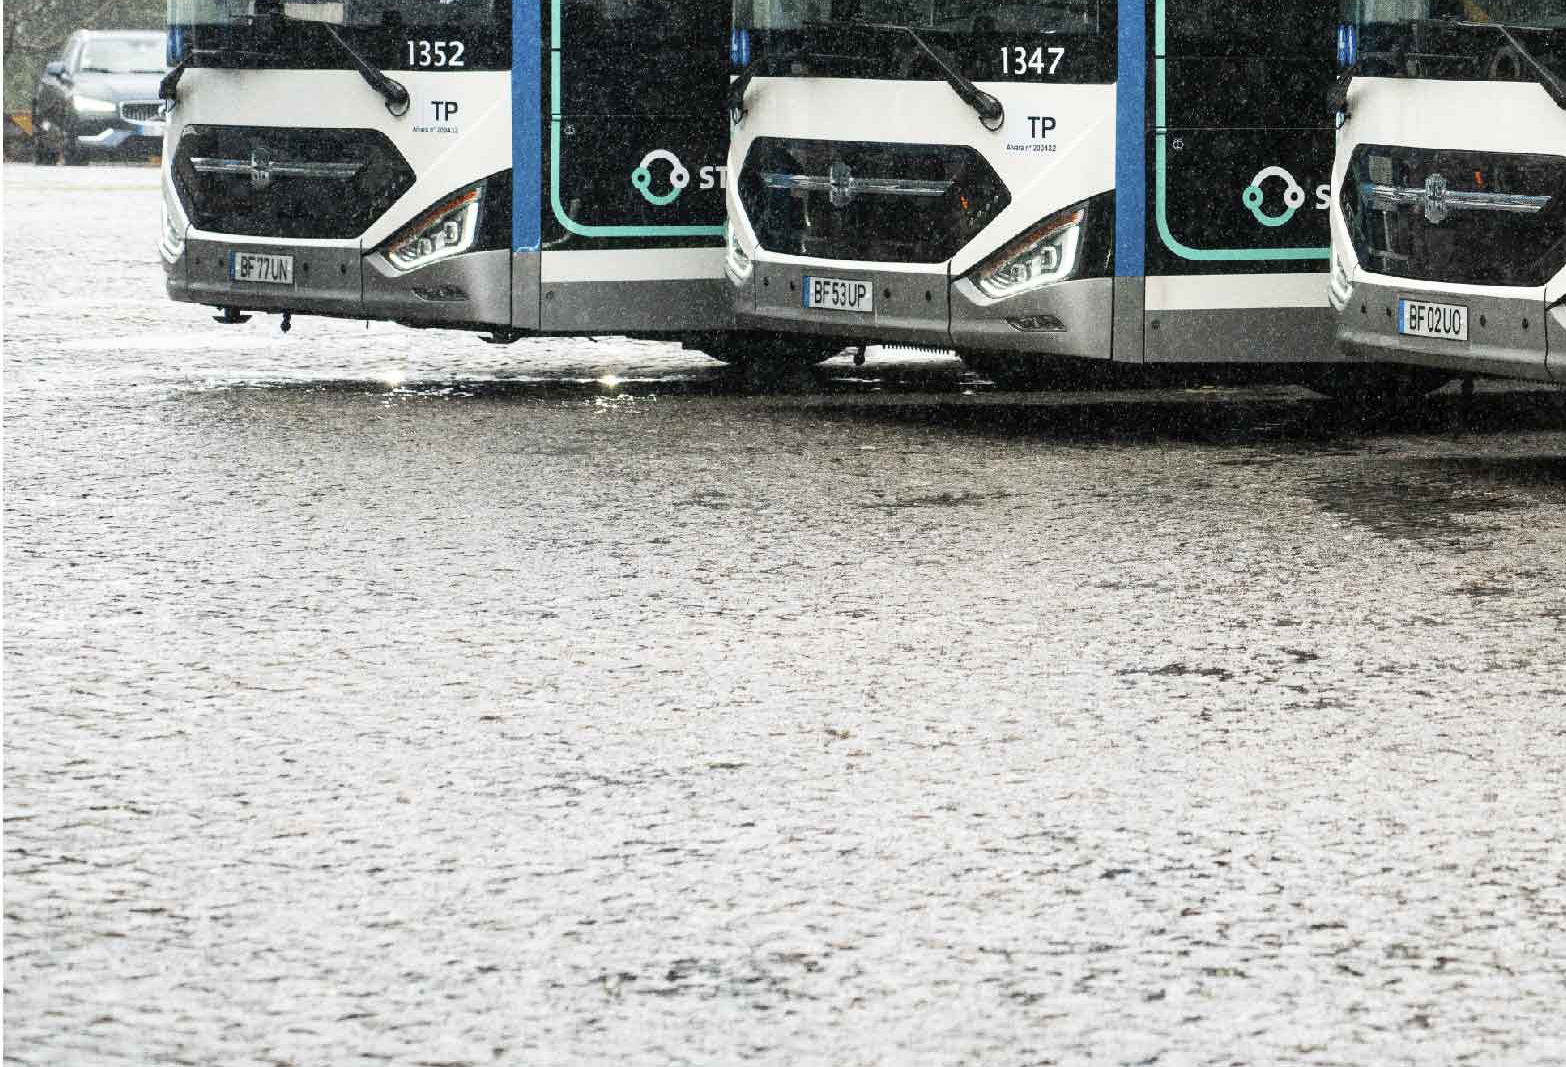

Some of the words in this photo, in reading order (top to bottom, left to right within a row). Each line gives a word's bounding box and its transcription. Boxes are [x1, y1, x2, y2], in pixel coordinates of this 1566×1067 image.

[407, 41, 465, 66] 1352
[1001, 47, 1065, 74] 1347
[431, 101, 458, 121] TP
[1027, 116, 1056, 138] TP
